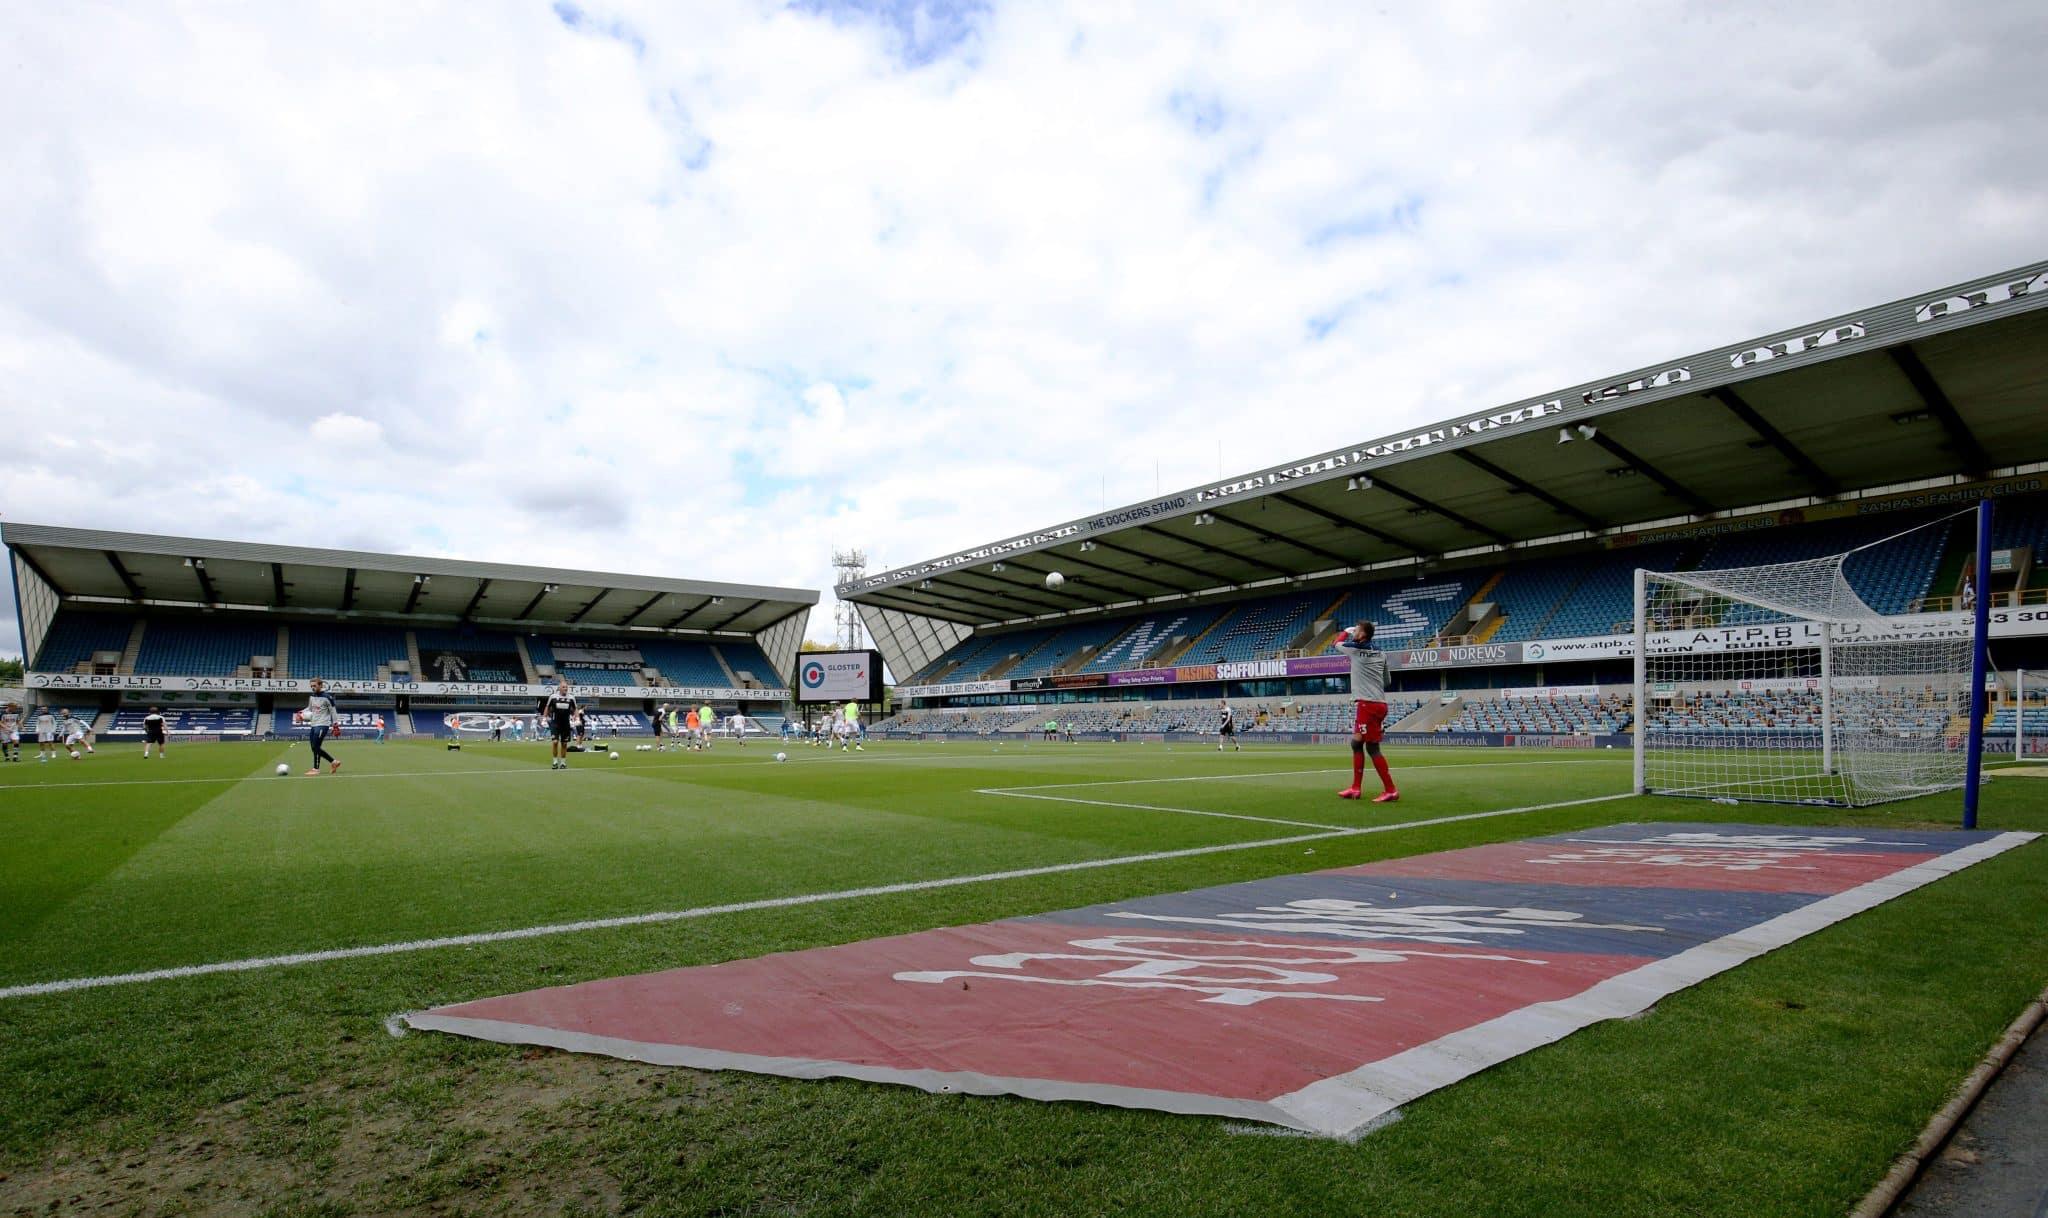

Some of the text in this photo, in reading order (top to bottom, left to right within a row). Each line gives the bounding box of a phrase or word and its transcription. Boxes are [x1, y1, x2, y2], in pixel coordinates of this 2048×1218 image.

[1928, 487, 1986, 505] FAMILY
[1992, 480, 2041, 495] CLUB
[1088, 497, 1185, 531] THE DOCKERS STAND
[1692, 523, 1735, 538] FAMILY
[1738, 518, 1773, 530] CLUB
[1692, 622, 1861, 644] A.T.P.B LD
[1552, 637, 1671, 651] www.atpb.c.uk
[1618, 640, 1792, 656] DSIGN BUILD
[827, 663, 861, 671] GLOSTER
[1176, 666, 1216, 681] MASONS
[1217, 661, 1287, 679] SCAFFOLDING
[52, 675, 162, 685] A.T.P.B LTD
[202, 679, 261, 687] A.T.P.B
[392, 682, 419, 690] LTD
[503, 684, 528, 692] LTD
[1389, 735, 1488, 746] www.baxterlambert.co.uk
